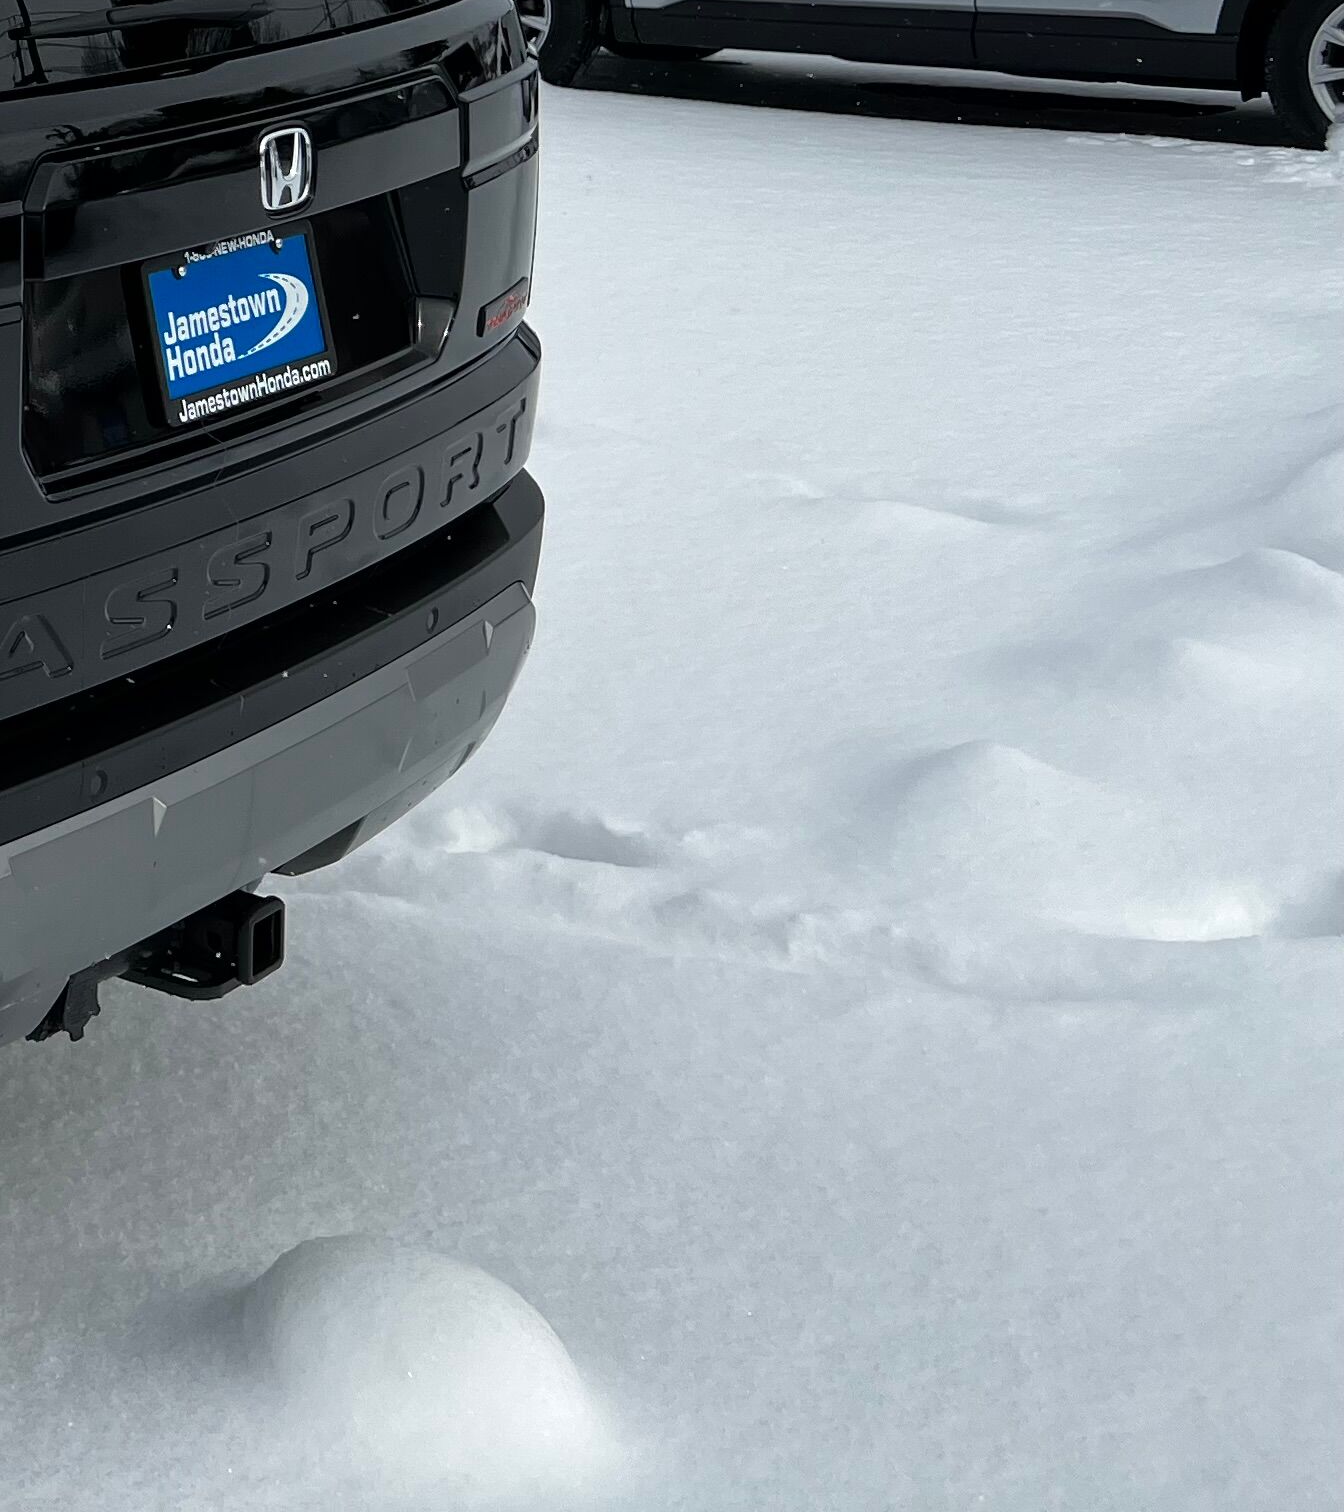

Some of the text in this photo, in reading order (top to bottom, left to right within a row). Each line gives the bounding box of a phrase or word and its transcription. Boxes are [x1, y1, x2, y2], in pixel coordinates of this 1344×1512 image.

[163, 288, 282, 346] Jamestown
[165, 332, 237, 382] Honda
[178, 359, 332, 423] JamestownHonda.com
